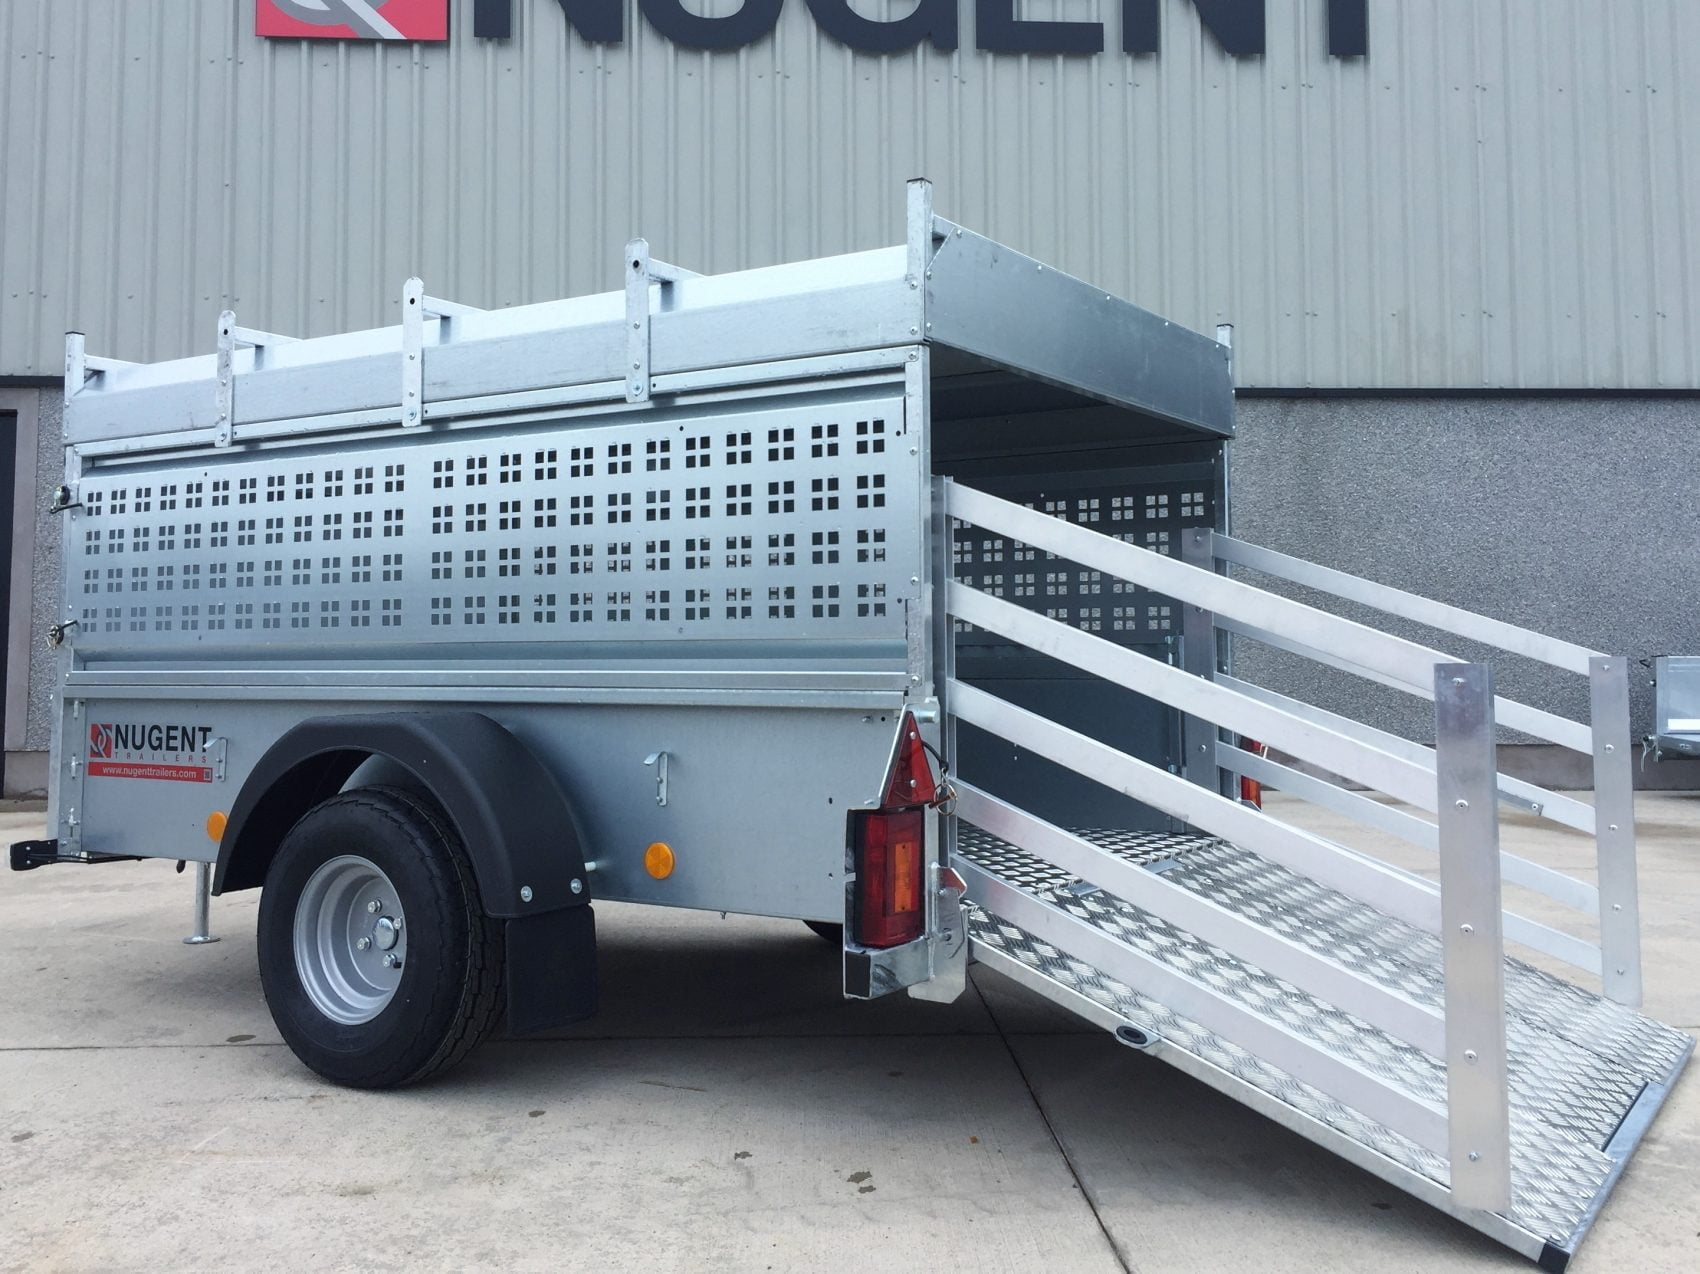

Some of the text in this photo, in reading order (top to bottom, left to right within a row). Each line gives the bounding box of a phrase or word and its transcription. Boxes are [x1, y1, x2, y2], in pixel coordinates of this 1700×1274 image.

[114, 723, 212, 753] NUGENT
[114, 751, 207, 764] TRAILERS
[102, 766, 197, 779] www.nugenttrailers.com
